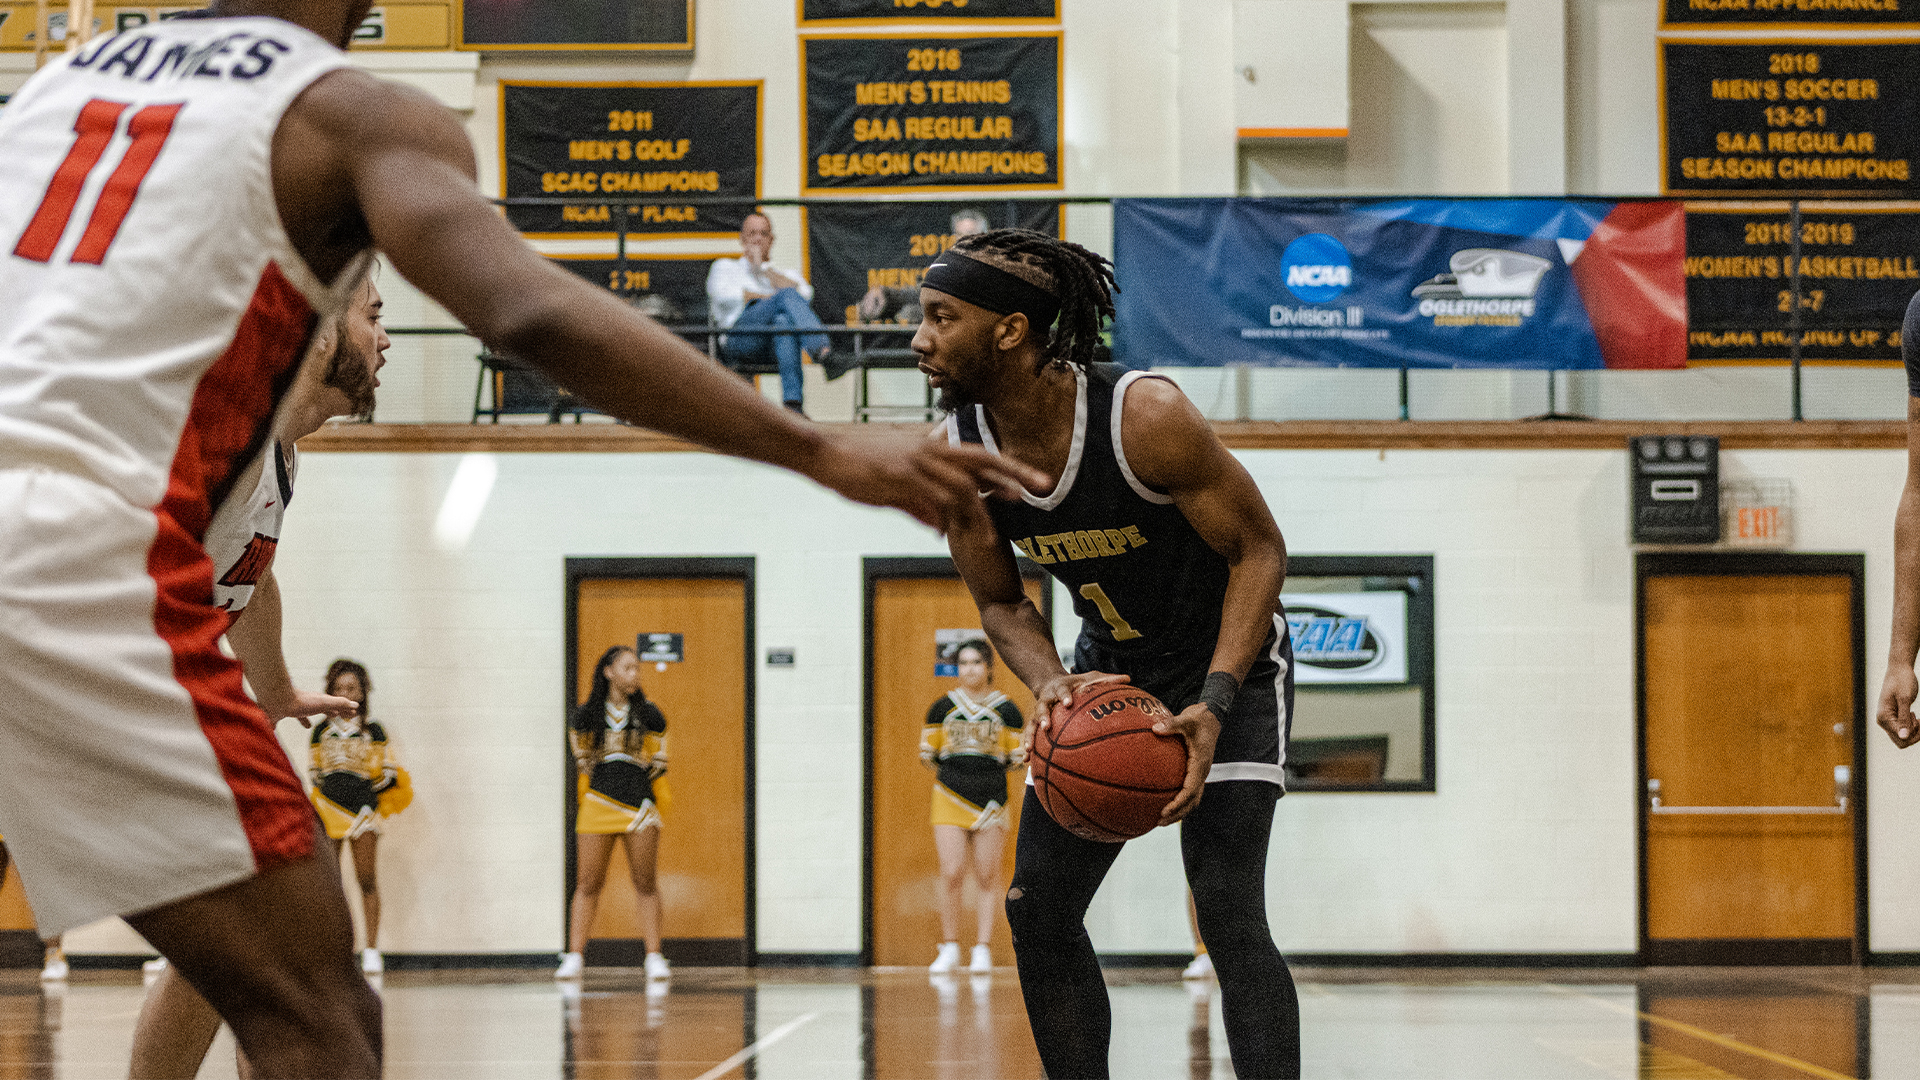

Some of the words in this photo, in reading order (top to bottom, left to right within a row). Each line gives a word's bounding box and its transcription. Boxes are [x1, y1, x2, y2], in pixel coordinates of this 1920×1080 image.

[69, 33, 290, 80] JAMES
[907, 49, 961, 71] 2016
[1769, 53, 1819, 73] 2018
[856, 82, 926, 105] MEN'S
[928, 80, 1011, 104] TENNIS
[1712, 79, 1779, 100] MEN'S
[1785, 79, 1878, 100] SOCCER
[608, 111, 653, 131] 2011
[1764, 106, 1826, 126] 13-2-1
[854, 118, 901, 142] SAA
[905, 116, 1012, 140] REGULAR
[569, 140, 631, 160] MEN'S
[636, 138, 691, 161] GOLF
[1716, 132, 1762, 152] SAA
[1768, 132, 1875, 153] REGULAR
[818, 153, 910, 177] SEASON
[914, 152, 1047, 175] CHAMPIONS
[1681, 158, 1774, 179] SEASON
[1778, 158, 1909, 180] CHAMPIONS
[13, 98, 187, 265] 11
[542, 172, 597, 192] SCAC
[601, 171, 719, 192] CHAMPIONS
[909, 234, 957, 256] 201
[1288, 265, 1351, 287] NCAA
[1684, 256, 1779, 278] WOMEN'S
[1270, 304, 1345, 327] Division
[1346, 306, 1364, 327] III
[1419, 299, 1534, 317] OGLETHORPE
[1738, 507, 1778, 538] EXIT
[1014, 524, 1148, 565] LETHORPE
[1079, 582, 1143, 641] 1
